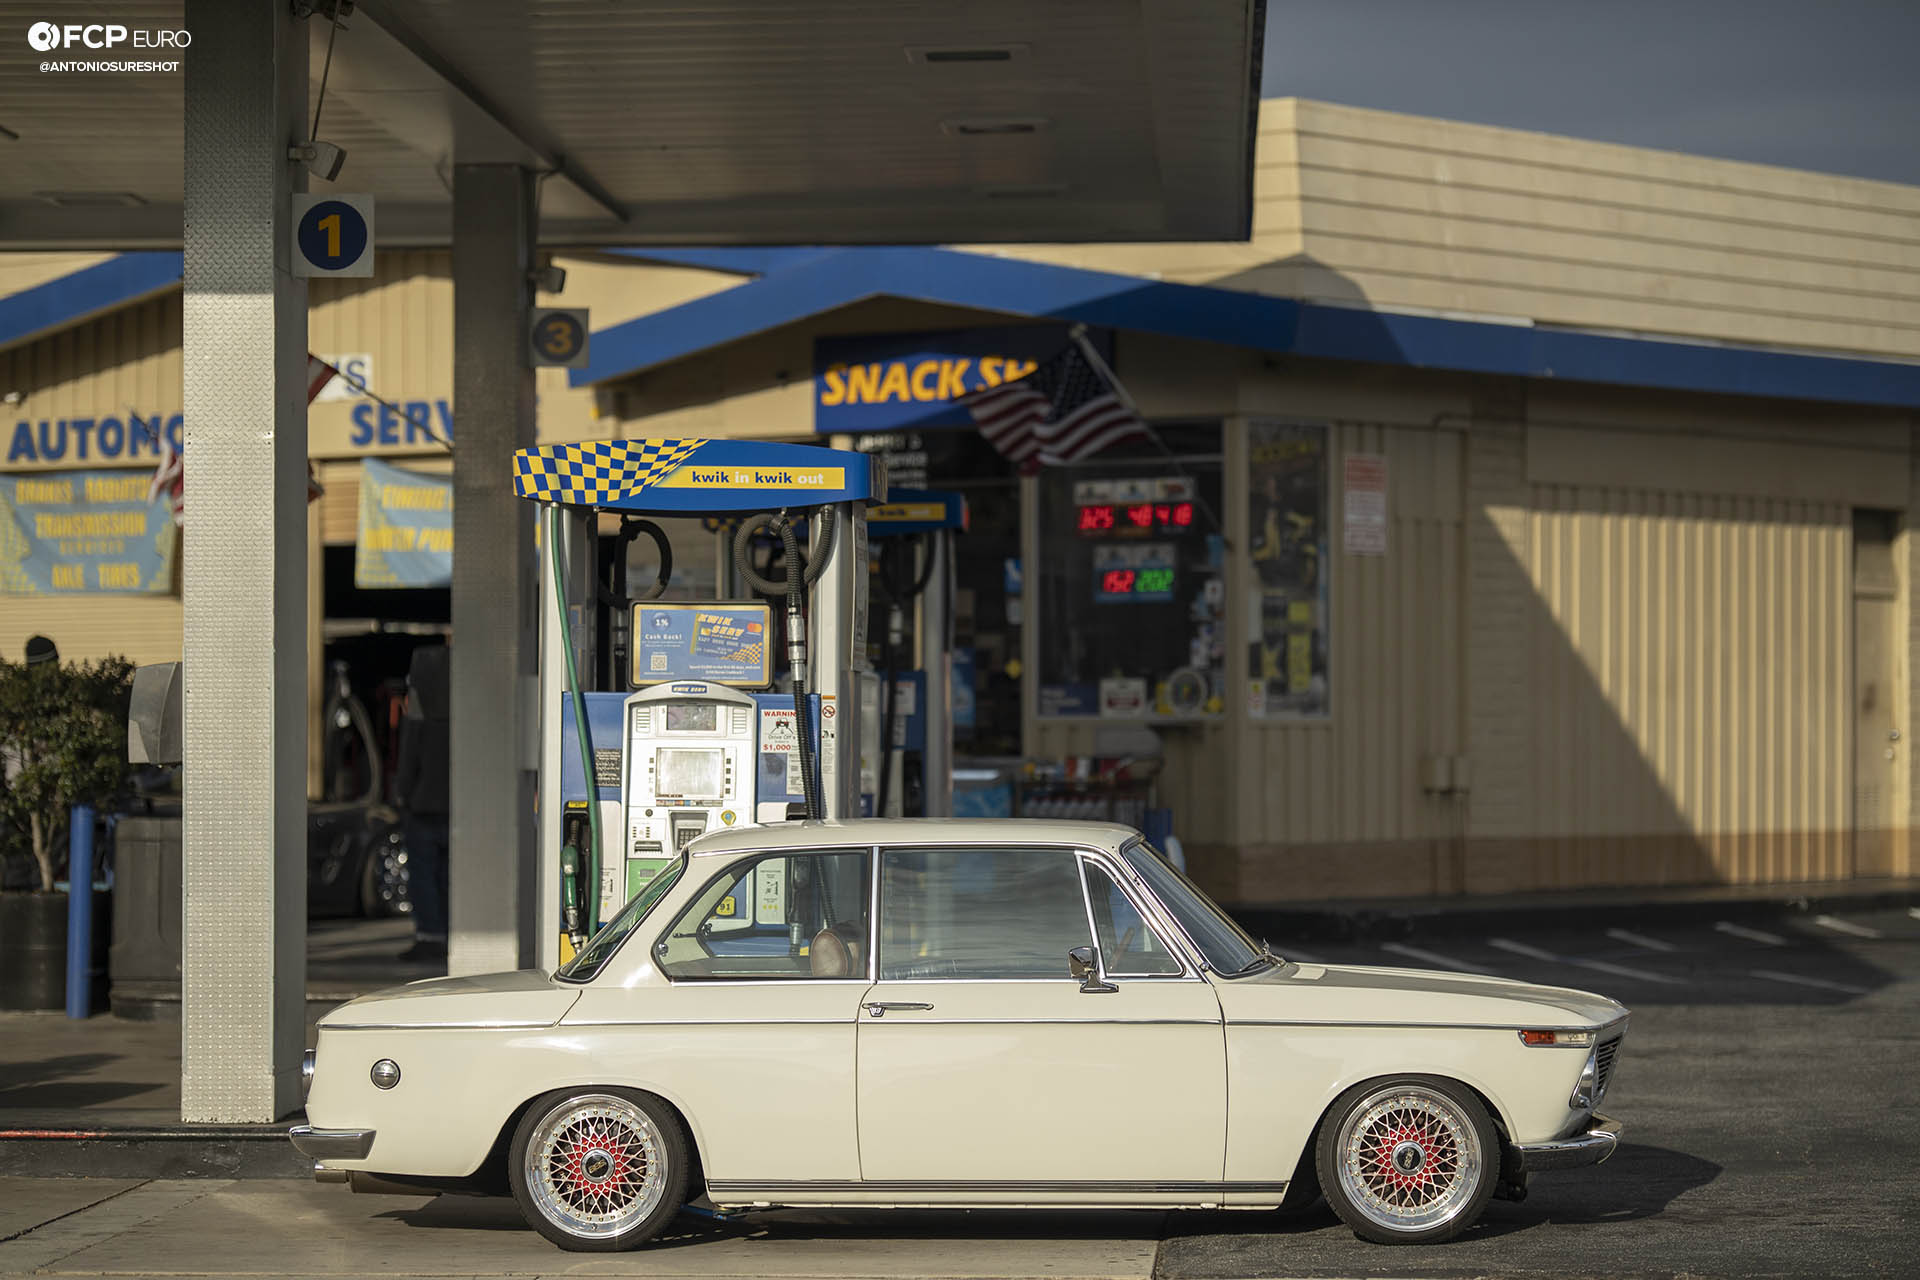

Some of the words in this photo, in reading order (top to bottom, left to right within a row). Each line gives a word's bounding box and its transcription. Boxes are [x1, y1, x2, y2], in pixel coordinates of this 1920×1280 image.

[318, 213, 342, 257] 1
[545, 321, 573, 354] 3
[821, 358, 971, 406] SNACK
[692, 471, 730, 483] kwik
[735, 471, 750, 484] in
[755, 472, 793, 484] kwik
[797, 473, 824, 485] out
[655, 618, 669, 627] 1%
[697, 613, 733, 626] KWIK
[663, 632, 682, 640] Back!
[711, 624, 744, 637] SERV
[719, 903, 731, 911] 91
